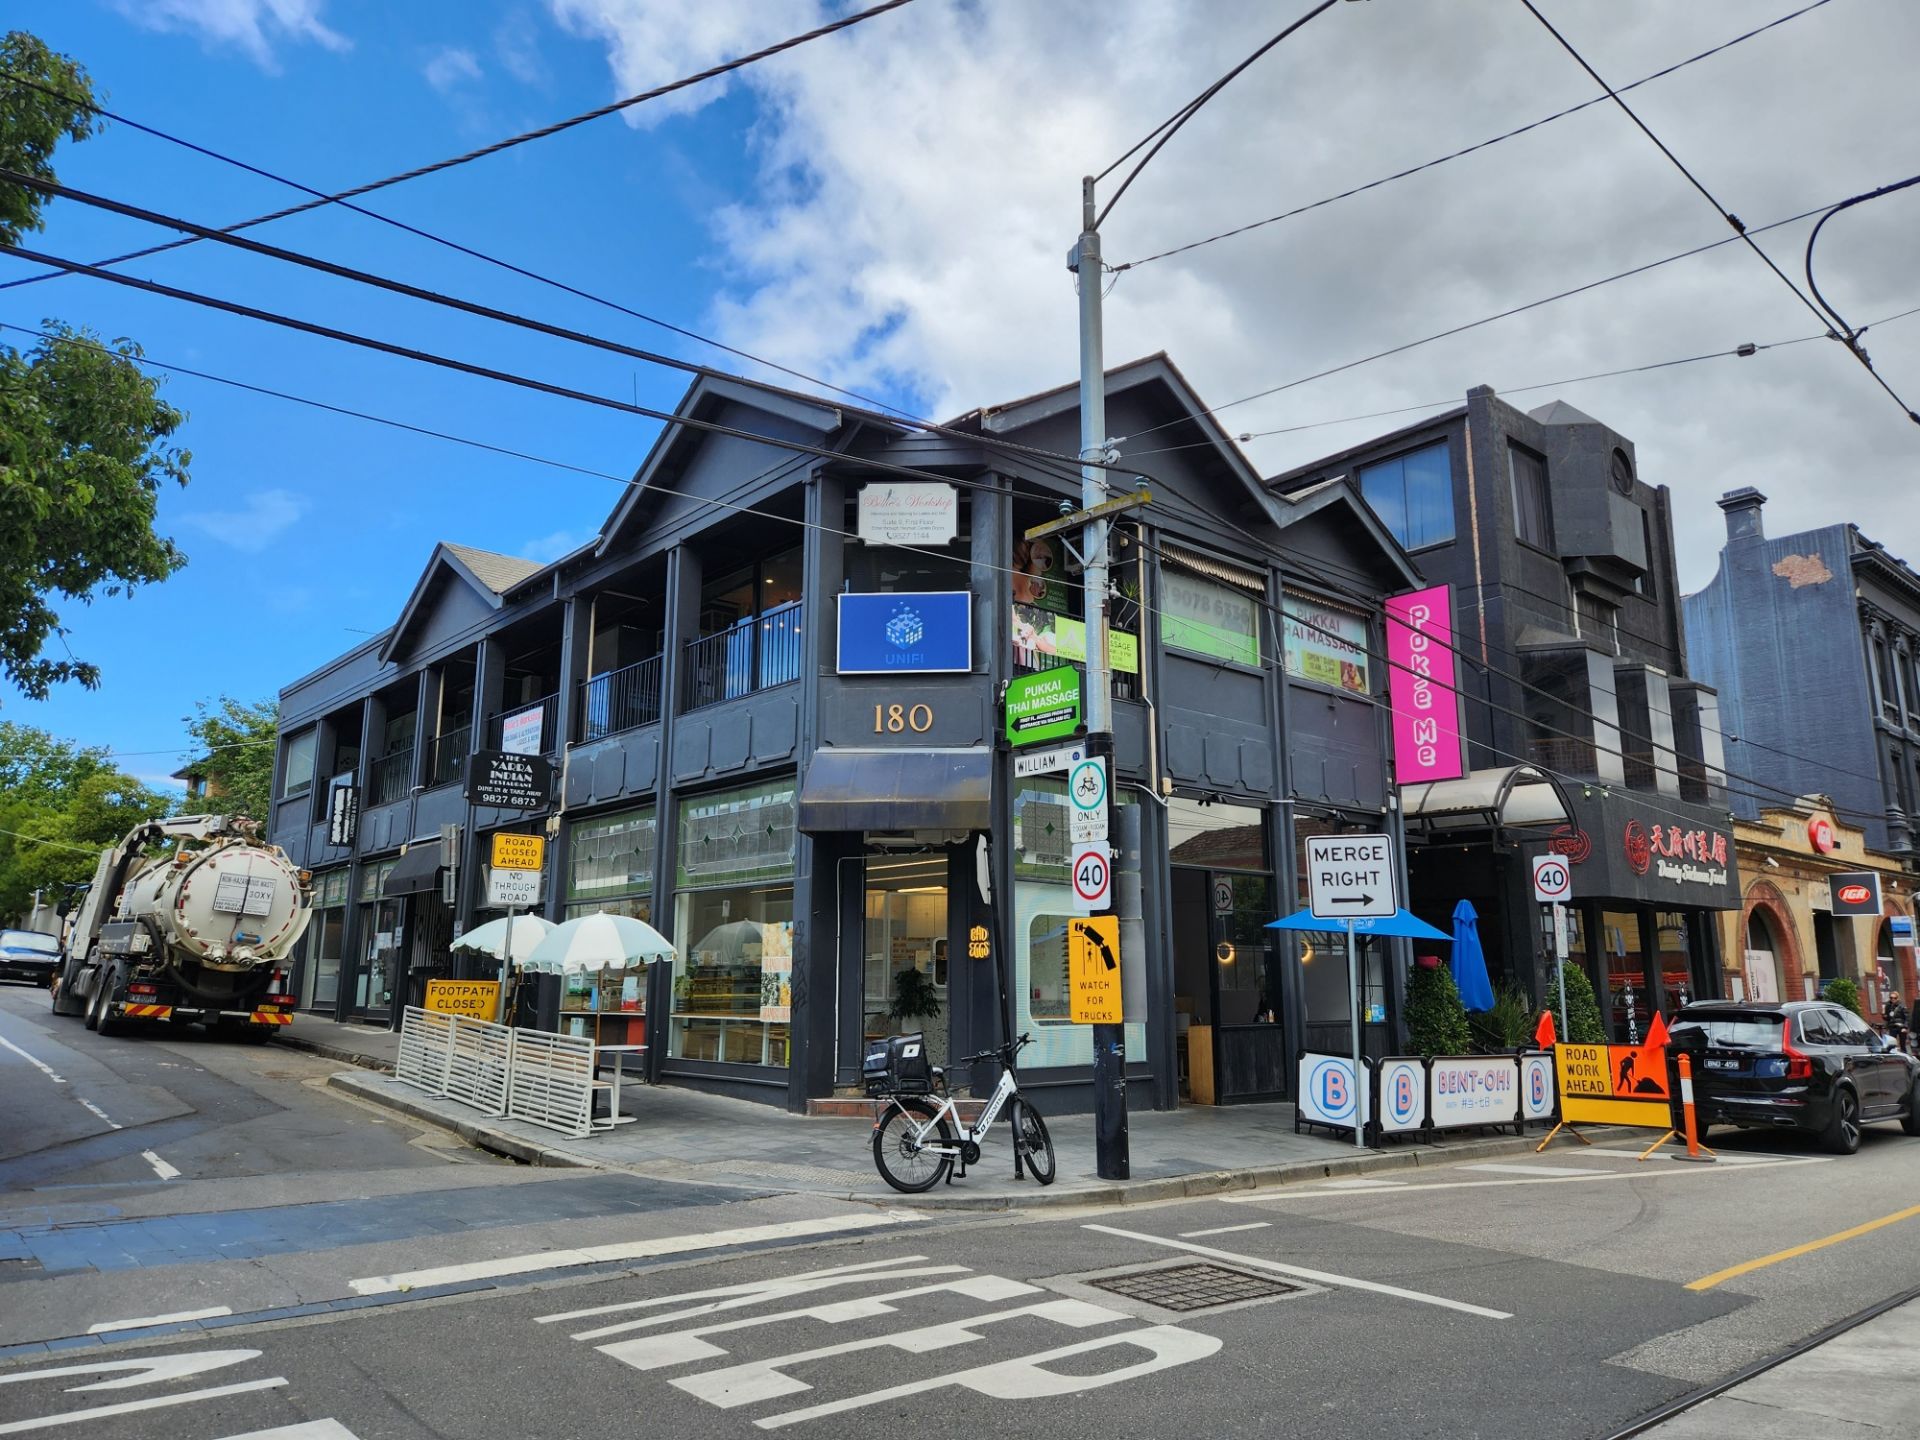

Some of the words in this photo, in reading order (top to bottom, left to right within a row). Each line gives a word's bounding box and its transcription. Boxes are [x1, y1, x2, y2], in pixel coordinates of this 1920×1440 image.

[905, 493, 953, 511] Workshop
[1284, 622, 1304, 640] HAI
[1110, 640, 1131, 652] SSAGE
[885, 653, 924, 664] UNIFI
[1024, 679, 1062, 698] PUKKAI
[1008, 702, 1030, 715] THAI
[1032, 688, 1080, 710] MASSAGE
[874, 703, 934, 734] 180
[491, 760, 533, 773] YARRA
[1018, 754, 1056, 774] WILLIAM
[490, 770, 532, 782] INDIAN
[490, 780, 532, 788] RESTAURANT
[482, 794, 508, 804] 9827
[511, 796, 536, 806] 6873
[1078, 810, 1101, 822] ONLY
[506, 838, 533, 847] ROAD
[500, 848, 537, 857] CLOSED
[1314, 846, 1384, 862] MERGE
[501, 857, 534, 866] AHEAD
[1079, 865, 1103, 886] 40
[1322, 871, 1380, 886] RIGHT
[1540, 870, 1564, 886] 40
[495, 882, 536, 891] THROUGH
[1842, 888, 1866, 900] IGA
[970, 925, 988, 941] BAD
[969, 941, 990, 958] EGGS
[431, 986, 494, 996] FOOTPATH
[1080, 981, 1110, 990] WATCH
[437, 1000, 485, 1008] CLOSED
[1086, 996, 1104, 1005] FOR
[1080, 1012, 1113, 1020] TRUCKS
[1566, 1048, 1597, 1060] ROAD
[1566, 1064, 1600, 1076] WORK
[1438, 1069, 1510, 1094] BENT-OH!
[1532, 1068, 1544, 1105] B
[1566, 1080, 1605, 1092] AHEAD
[1323, 1068, 1348, 1110] B
[1396, 1074, 1412, 1116] B
